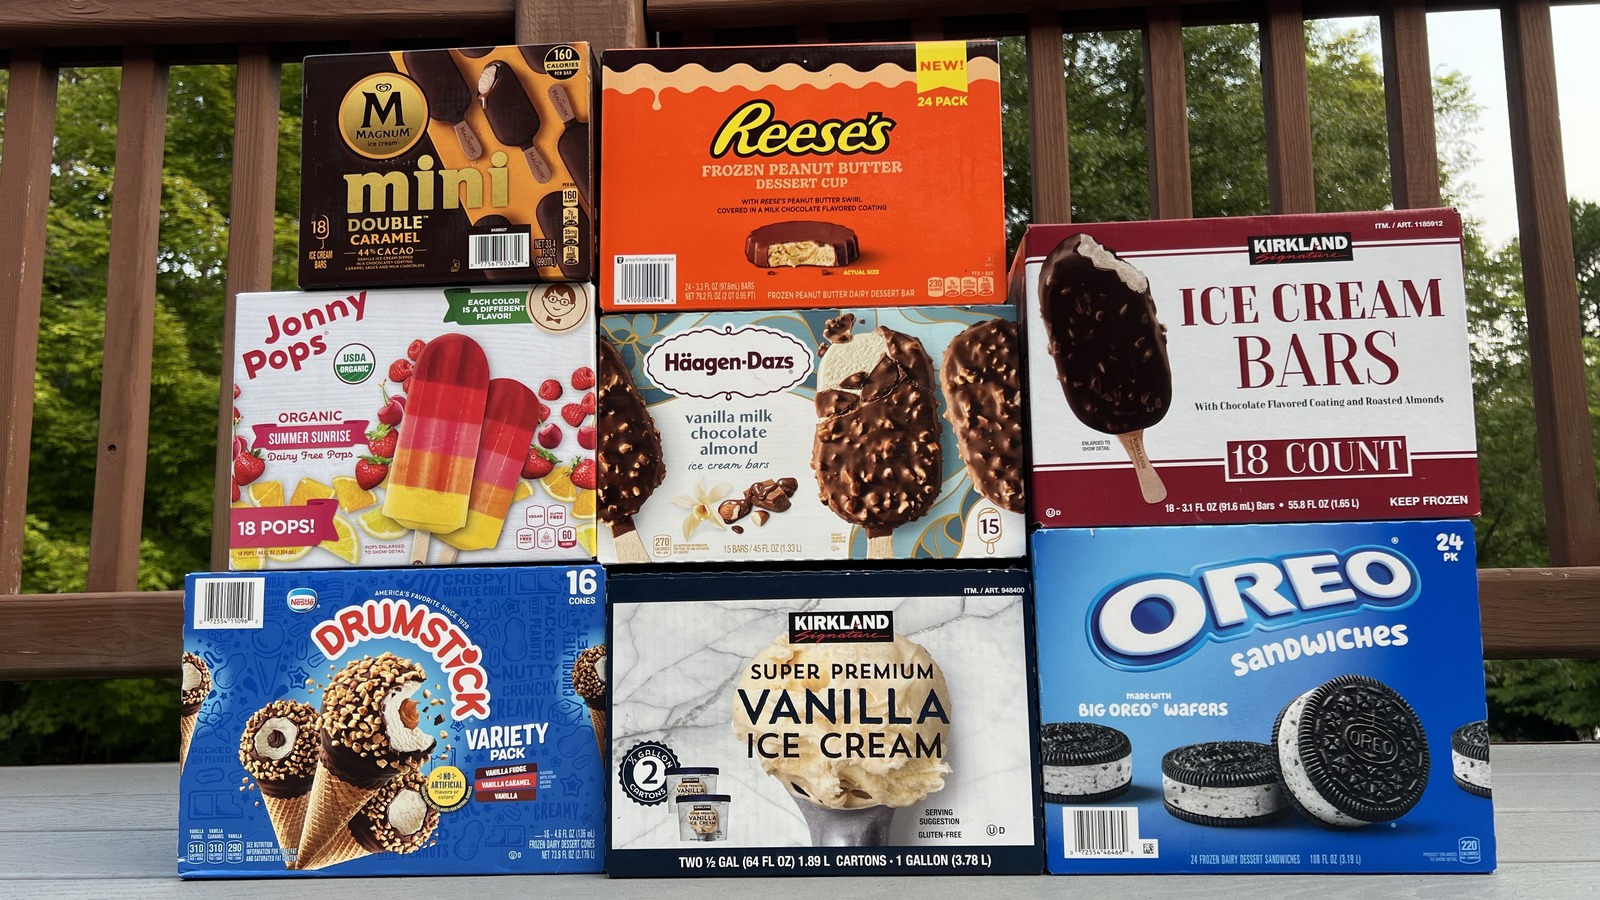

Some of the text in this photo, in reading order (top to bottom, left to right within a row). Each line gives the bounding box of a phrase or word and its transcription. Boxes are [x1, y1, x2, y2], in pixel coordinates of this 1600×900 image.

[554, 49, 573, 60] 160
[920, 60, 964, 72] NEW!
[917, 96, 968, 107] 24 PACK
[360, 91, 406, 128] M
[355, 128, 411, 139] MAGNUM
[711, 101, 895, 157] Reese's
[701, 161, 903, 178] FROZEN PEANUT BUTTER
[343, 151, 509, 214] mini
[755, 177, 848, 190] DESSERT CUP
[815, 196, 841, 204] BUTTER
[781, 205, 821, 213] CHOCOLATE
[858, 204, 887, 212] COATING
[311, 220, 326, 234] 18
[347, 215, 423, 232] DOUBLE
[1414, 220, 1444, 228] 1185912
[350, 232, 421, 246] CARAMEL
[1253, 235, 1349, 254] KIRKLAND
[358, 247, 414, 256] 44% CACAO
[1255, 250, 1349, 265] Signature
[928, 279, 943, 288] 230
[767, 289, 915, 300] FROZEN PEANUT BUTTER DAIRY DESSERT BAR
[481, 305, 526, 313] DIFFERENT
[1179, 278, 1446, 327] ICE CREAM
[265, 290, 367, 344] Jonny
[242, 335, 327, 380] Pops
[343, 353, 367, 363] USDA
[664, 351, 794, 376] Häagen-Dazs
[1233, 329, 1401, 390] BARS
[340, 365, 369, 373] ORGANIC
[1194, 395, 1444, 411] With Chocolate Flavored Coating and Roasted Almonds
[278, 410, 342, 423] ORGANIC
[685, 408, 772, 424] vanilla milk
[268, 430, 351, 445] SUMMER SUNRISE
[691, 425, 767, 440] chocolate
[700, 441, 758, 455] almond
[267, 450, 353, 463] Dairy Free Pops
[1232, 439, 1402, 475] 18 COUNT
[688, 459, 769, 470] ice cream bars
[1164, 498, 1359, 513] 18 3.1 FL OZ (91.6 mL) Bars 55.8 FL OZ (1.65 L)
[1390, 495, 1468, 507] KEEP FROZEN
[238, 518, 315, 536] 18 POPS!
[980, 517, 1000, 535] 15
[655, 537, 670, 547] 270
[723, 544, 748, 554] 15 BARS
[1436, 533, 1464, 551] 24
[1443, 552, 1459, 562] PK
[566, 568, 598, 595] 16
[568, 597, 596, 605] CONES
[1097, 549, 1413, 658] OREO
[374, 589, 470, 630] AMERICA'S FAVORITE SINCE 1928
[794, 614, 889, 630] KIRKLAND
[795, 629, 890, 645] Signature
[1230, 623, 1410, 677] SANDWICHES
[315, 603, 487, 717] DRUMSTICK
[750, 663, 934, 680] SUPER PREMIUM
[1126, 692, 1172, 700] made WITH
[737, 687, 950, 726] VANILLA
[1078, 703, 1106, 717] BIG
[1109, 703, 1152, 717] OREO
[465, 722, 549, 751] VARIETY
[1350, 730, 1393, 755] OREO
[747, 732, 942, 759] ICE CREAM
[490, 747, 526, 761] PACK
[637, 749, 673, 769] GALLON
[485, 765, 527, 777] VANILLA FUDGE
[641, 760, 658, 784] 2
[430, 780, 463, 789] ARTIFICIAL
[481, 780, 504, 789] VANILLA
[505, 778, 531, 787] CARAMEL
[629, 783, 667, 799] CARTONS
[494, 792, 518, 800] VANILLA
[925, 808, 954, 816] SERVING
[919, 817, 960, 825] SUGGESTION
[918, 831, 962, 839] GLUTEN-FREE
[678, 854, 992, 870] TWO ½ GAL (64 FL OZ) 1.89 L CARTONS 1 GALLON (3.78 L)
[1190, 854, 1301, 865] 24 FROZEN DAIRY DESSERT SANDWICHES
